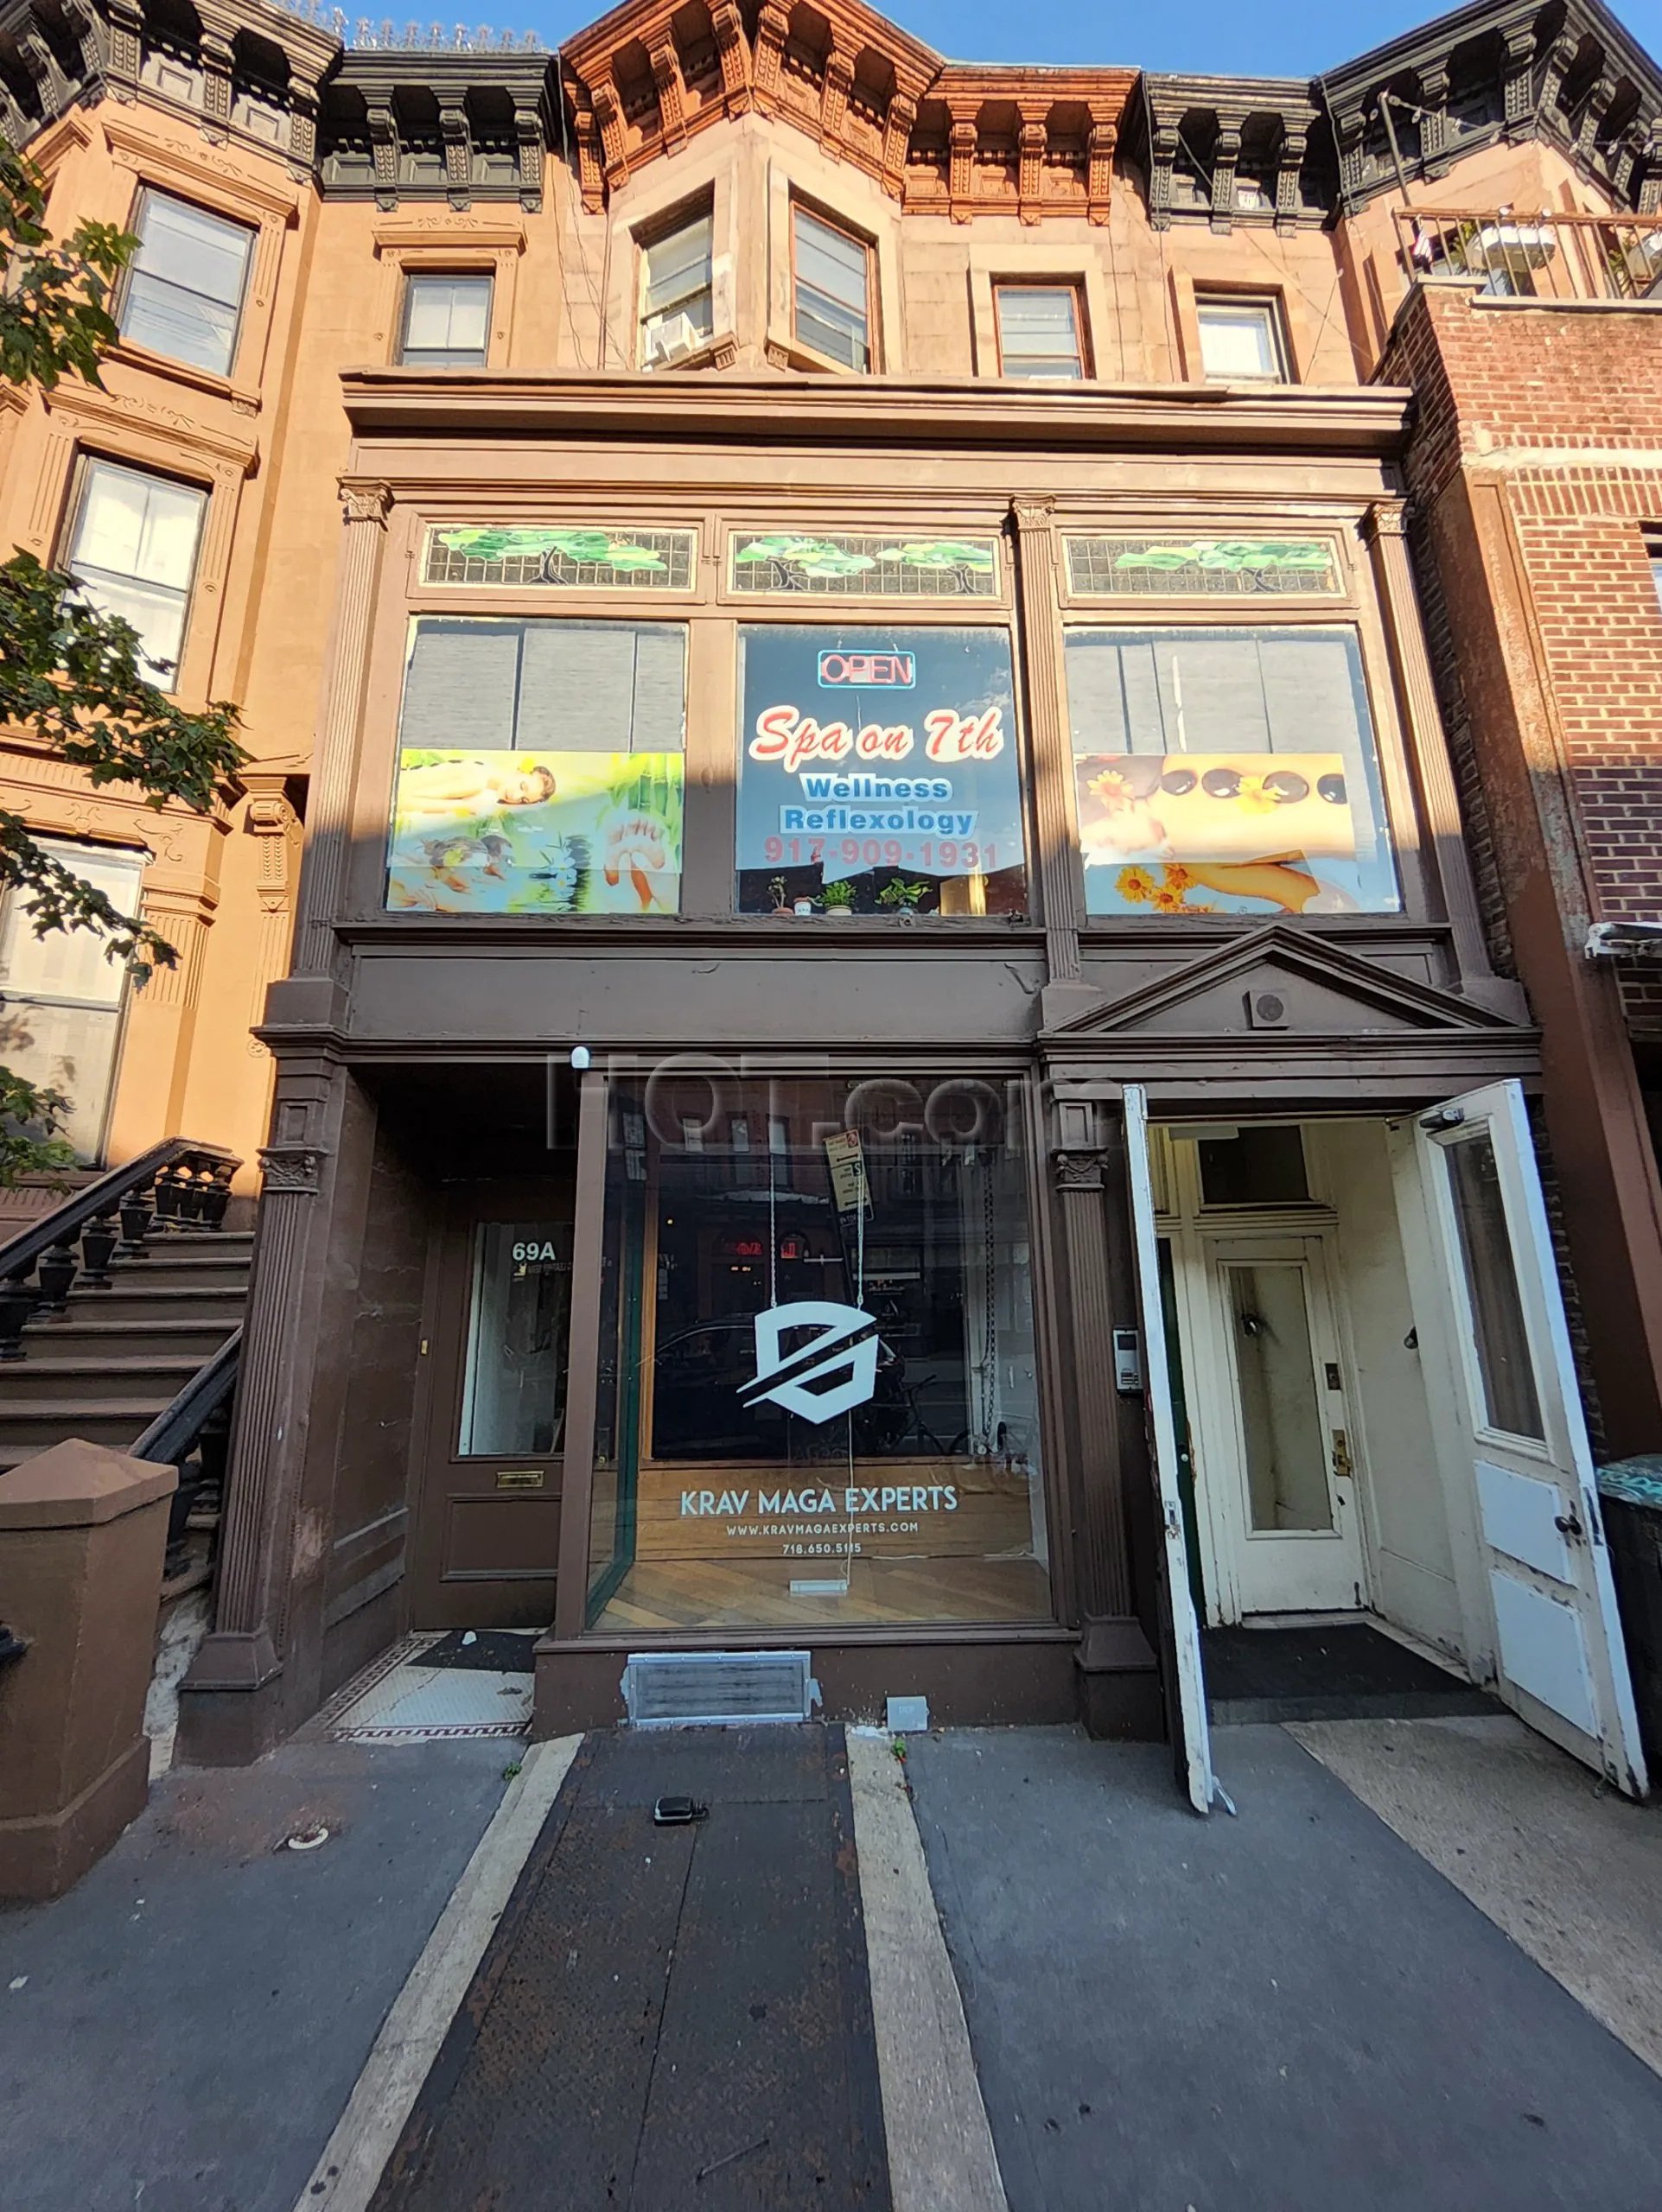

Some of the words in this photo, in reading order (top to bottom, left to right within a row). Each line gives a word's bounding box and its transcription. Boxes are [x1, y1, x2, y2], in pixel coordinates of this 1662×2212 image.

[822, 654, 911, 683] OPEN
[751, 707, 851, 771] Spa
[857, 726, 913, 758] on
[925, 708, 1003, 761] 7th
[805, 777, 949, 799] Wellness
[784, 806, 973, 836] Reflexology
[765, 836, 998, 868] 917-909-1931
[513, 1242, 556, 1261] 69A
[681, 1490, 749, 1516] KRAV
[758, 1489, 836, 1514] MAGA
[844, 1485, 958, 1513] EXPERTS
[726, 1522, 919, 1535] WWW.KRAVMAGAEXPERTS.COM
